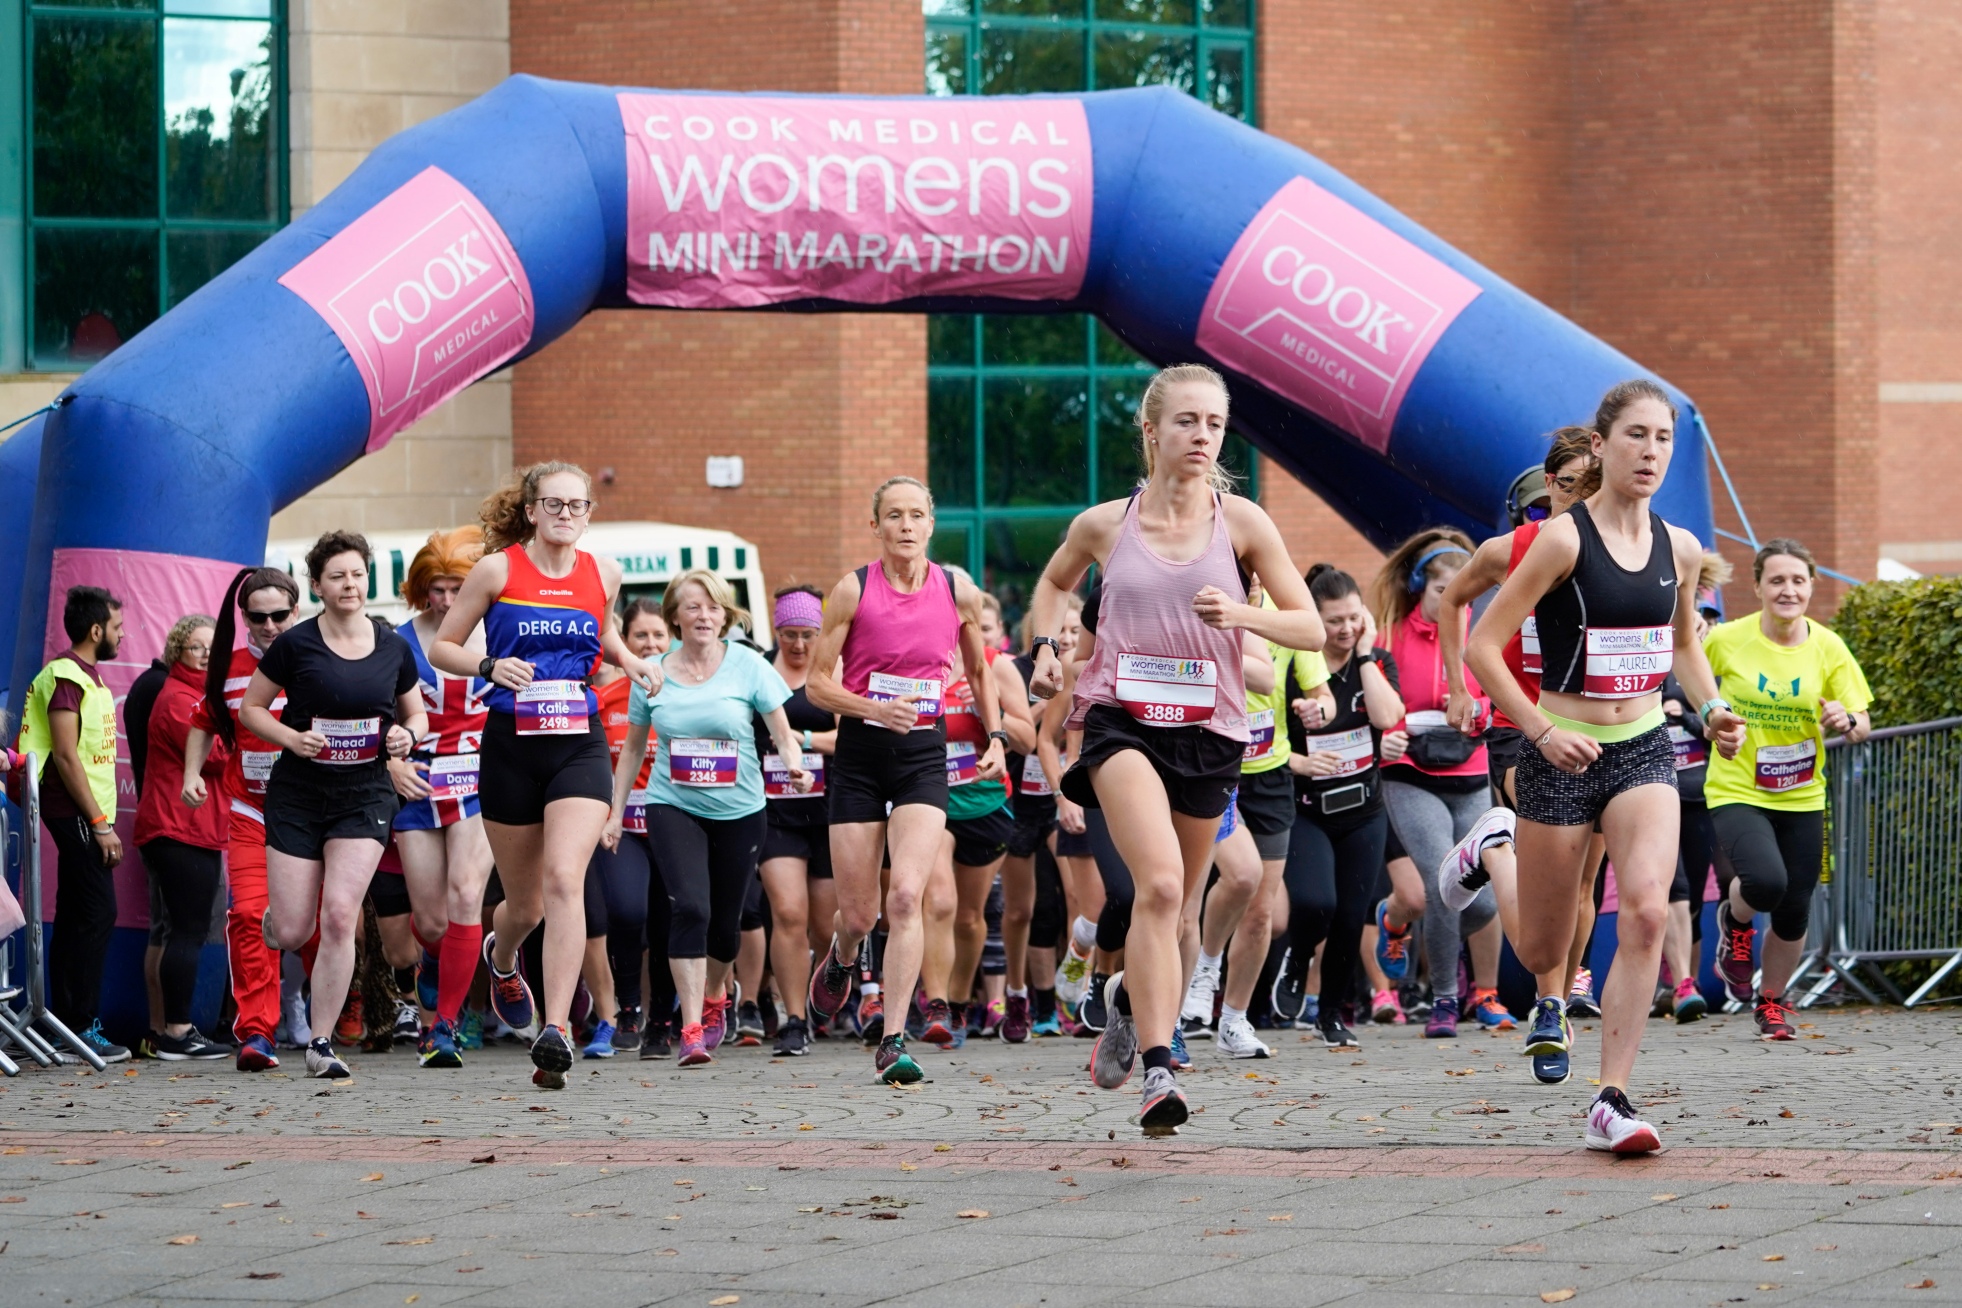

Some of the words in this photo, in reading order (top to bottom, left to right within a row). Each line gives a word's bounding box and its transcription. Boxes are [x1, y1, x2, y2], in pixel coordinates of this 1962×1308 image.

[644, 115, 799, 143] COOK
[829, 118, 1069, 146] MEDICAL
[650, 153, 1072, 219] womens
[648, 232, 759, 274] MINI
[774, 231, 1069, 274] MARATHON
[367, 233, 492, 345] COOK
[1262, 244, 1406, 355] COOK
[433, 308, 499, 365] MEDICAL
[1279, 331, 1357, 390] MEDICAL
[518, 620, 562, 637] DERG
[566, 620, 595, 637] A.C.
[1600, 635, 1642, 643] womens
[1131, 660, 1176, 672] womens
[1608, 656, 1657, 672] LAUREN
[1613, 675, 1649, 692] 3517
[537, 701, 570, 715] Katie
[1143, 704, 1185, 722] 3888
[539, 716, 569, 729] 2498
[330, 749, 359, 761] 2620
[691, 757, 717, 771] Kitty
[1760, 760, 1813, 776] Catherine
[446, 773, 476, 785] Dave
[689, 770, 717, 783] 2345
[1776, 774, 1799, 788] 1201
[448, 784, 475, 795] 2907
